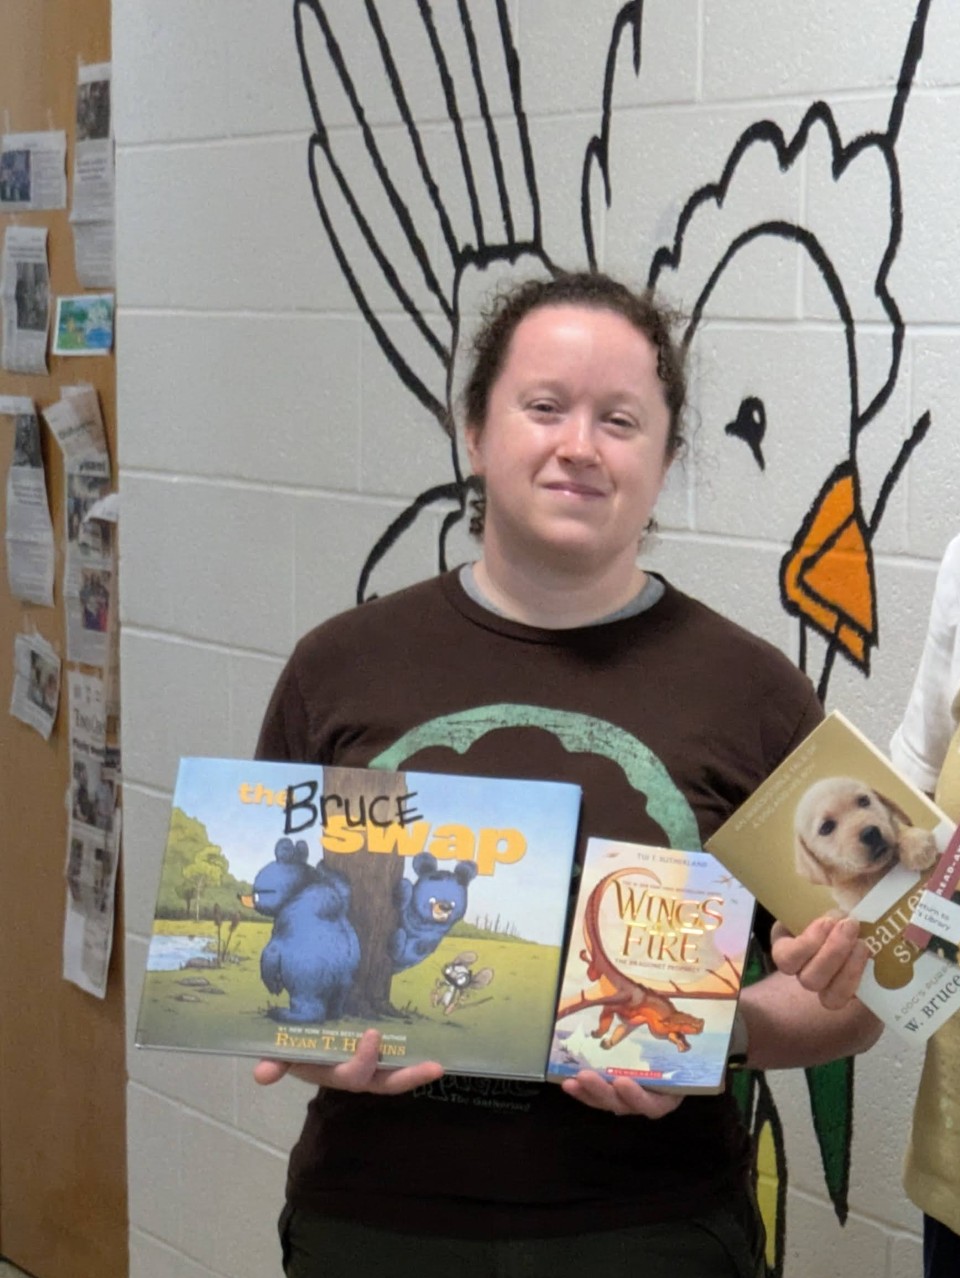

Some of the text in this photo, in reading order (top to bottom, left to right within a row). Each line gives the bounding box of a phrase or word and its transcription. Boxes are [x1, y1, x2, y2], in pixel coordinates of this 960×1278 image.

[320, 815, 528, 876] swap
[612, 878, 724, 931] WINGS
[622, 921, 705, 965] FIRE
[904, 1017, 925, 1034] W.
